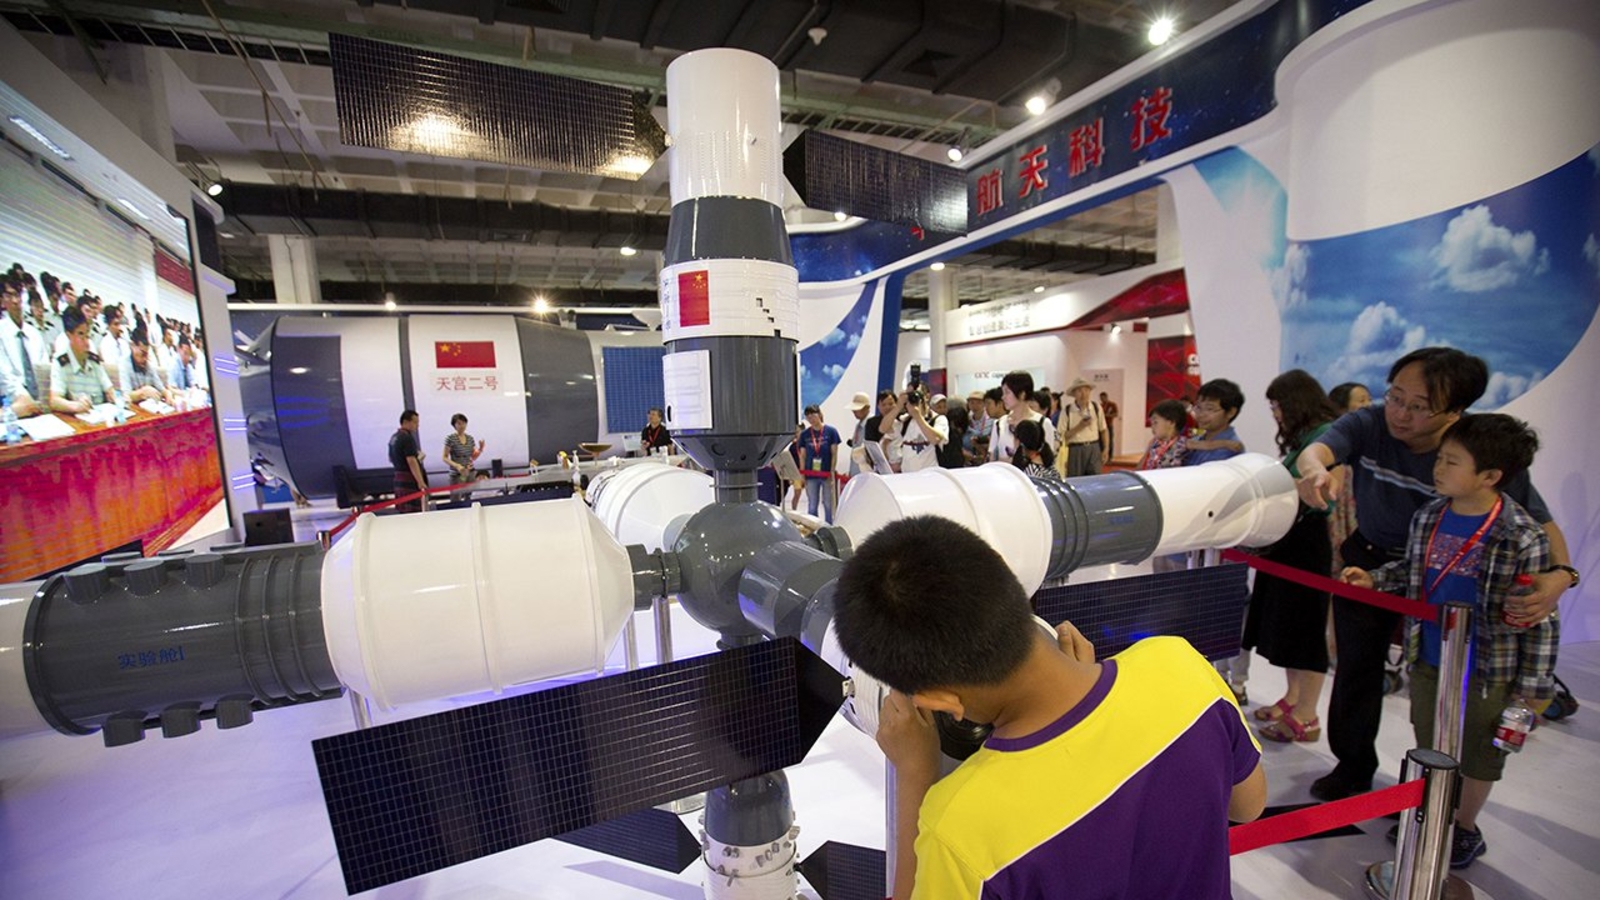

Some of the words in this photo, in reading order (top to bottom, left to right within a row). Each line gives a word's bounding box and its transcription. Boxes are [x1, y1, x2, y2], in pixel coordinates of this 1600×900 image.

[977, 86, 1173, 216] 航天科技
[436, 376, 498, 391] 天宫二号
